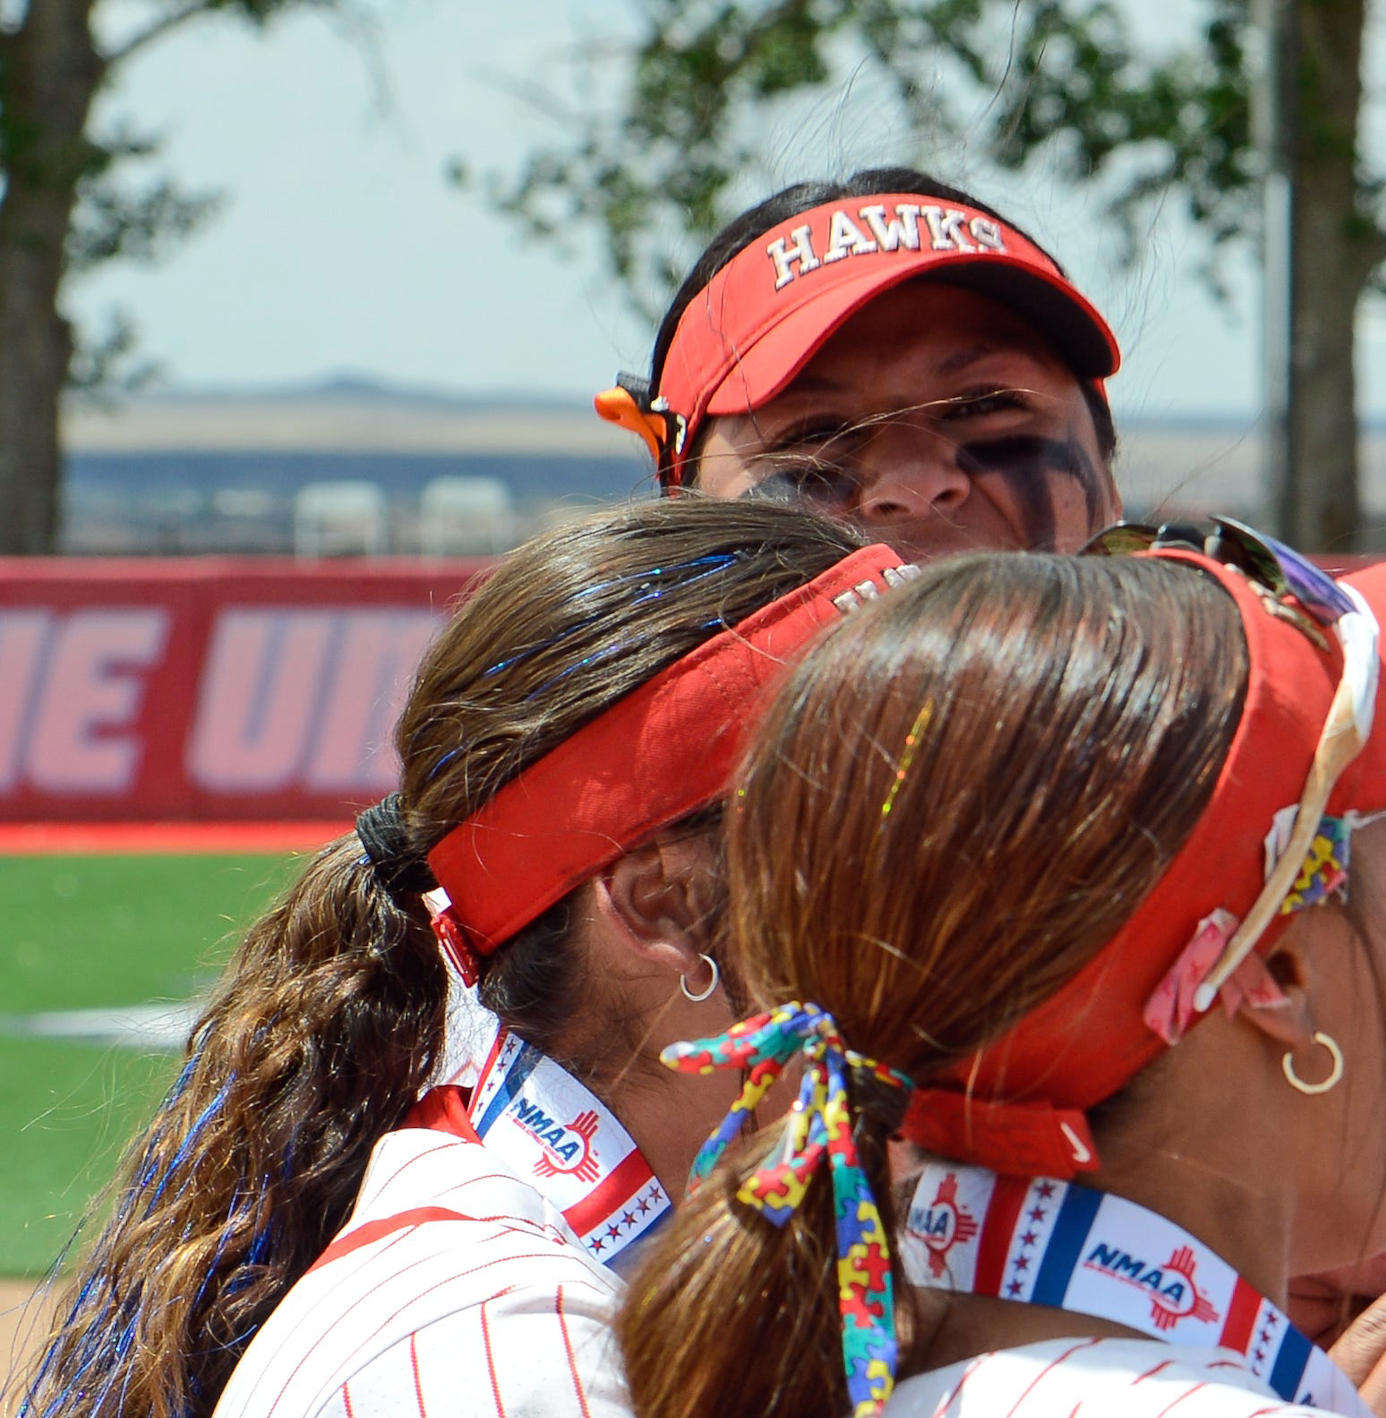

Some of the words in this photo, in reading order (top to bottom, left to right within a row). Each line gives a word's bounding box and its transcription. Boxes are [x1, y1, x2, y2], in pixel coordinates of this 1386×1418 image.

[766, 203, 1007, 291] HAWKS
[510, 1097, 581, 1162] NMAA
[1087, 1242, 1186, 1303] NMAA
